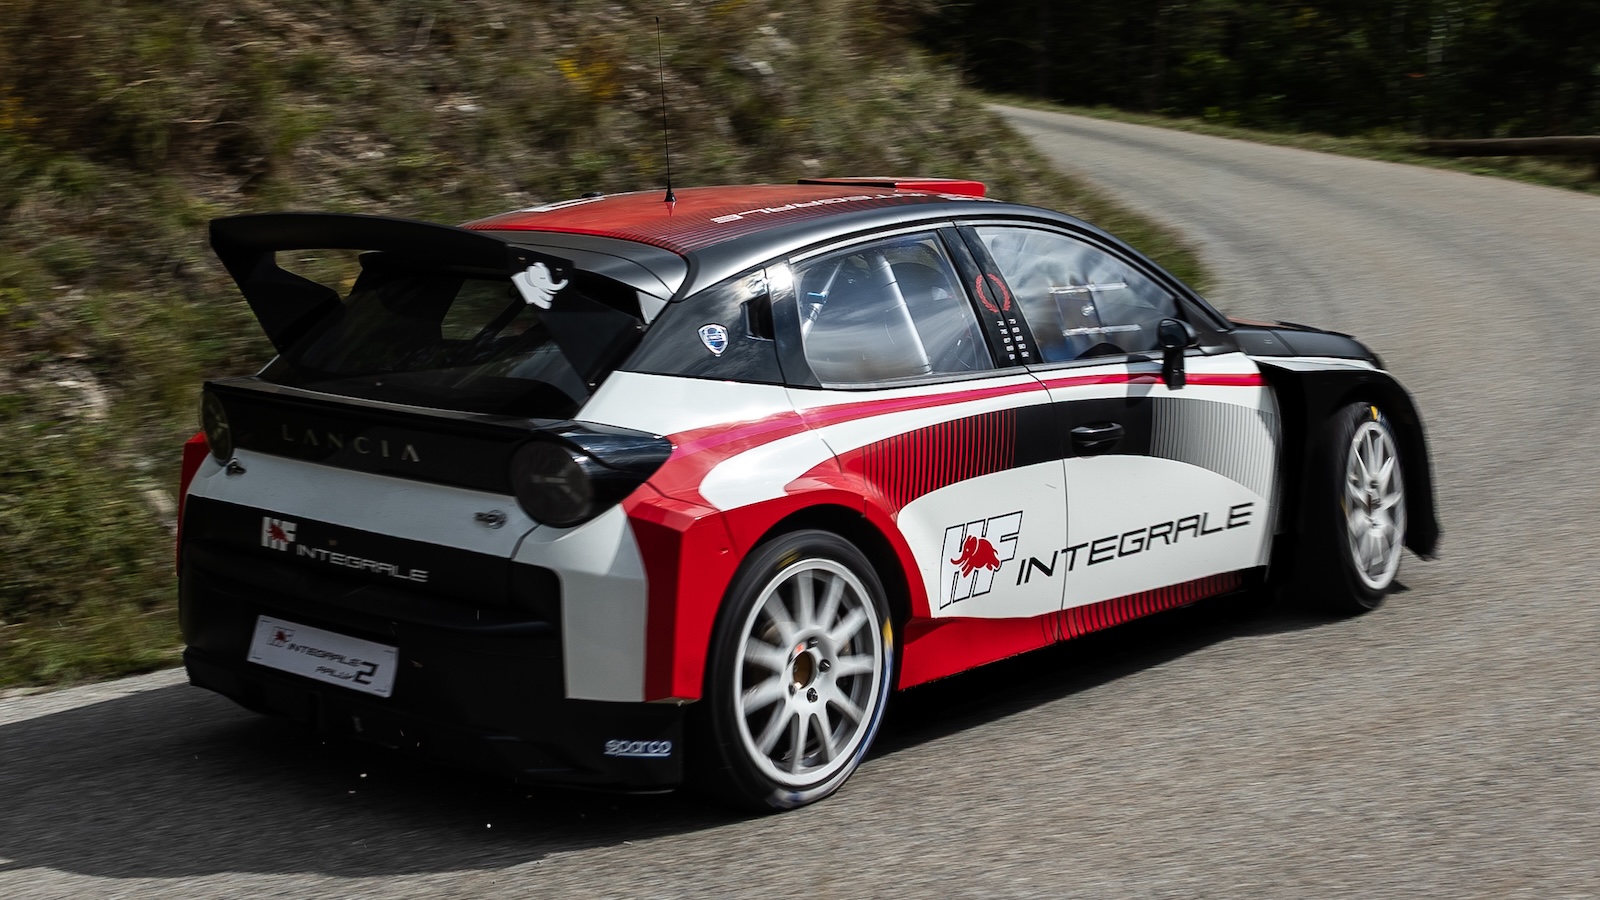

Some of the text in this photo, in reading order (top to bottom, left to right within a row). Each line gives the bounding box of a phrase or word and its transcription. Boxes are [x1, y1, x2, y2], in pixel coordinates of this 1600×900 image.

[280, 422, 420, 464] LANCIA
[297, 544, 429, 583] INTEGRALE
[1016, 502, 1254, 586] INTEGRALE
[286, 642, 361, 666] INTEGRALE
[604, 739, 672, 757] sparco
